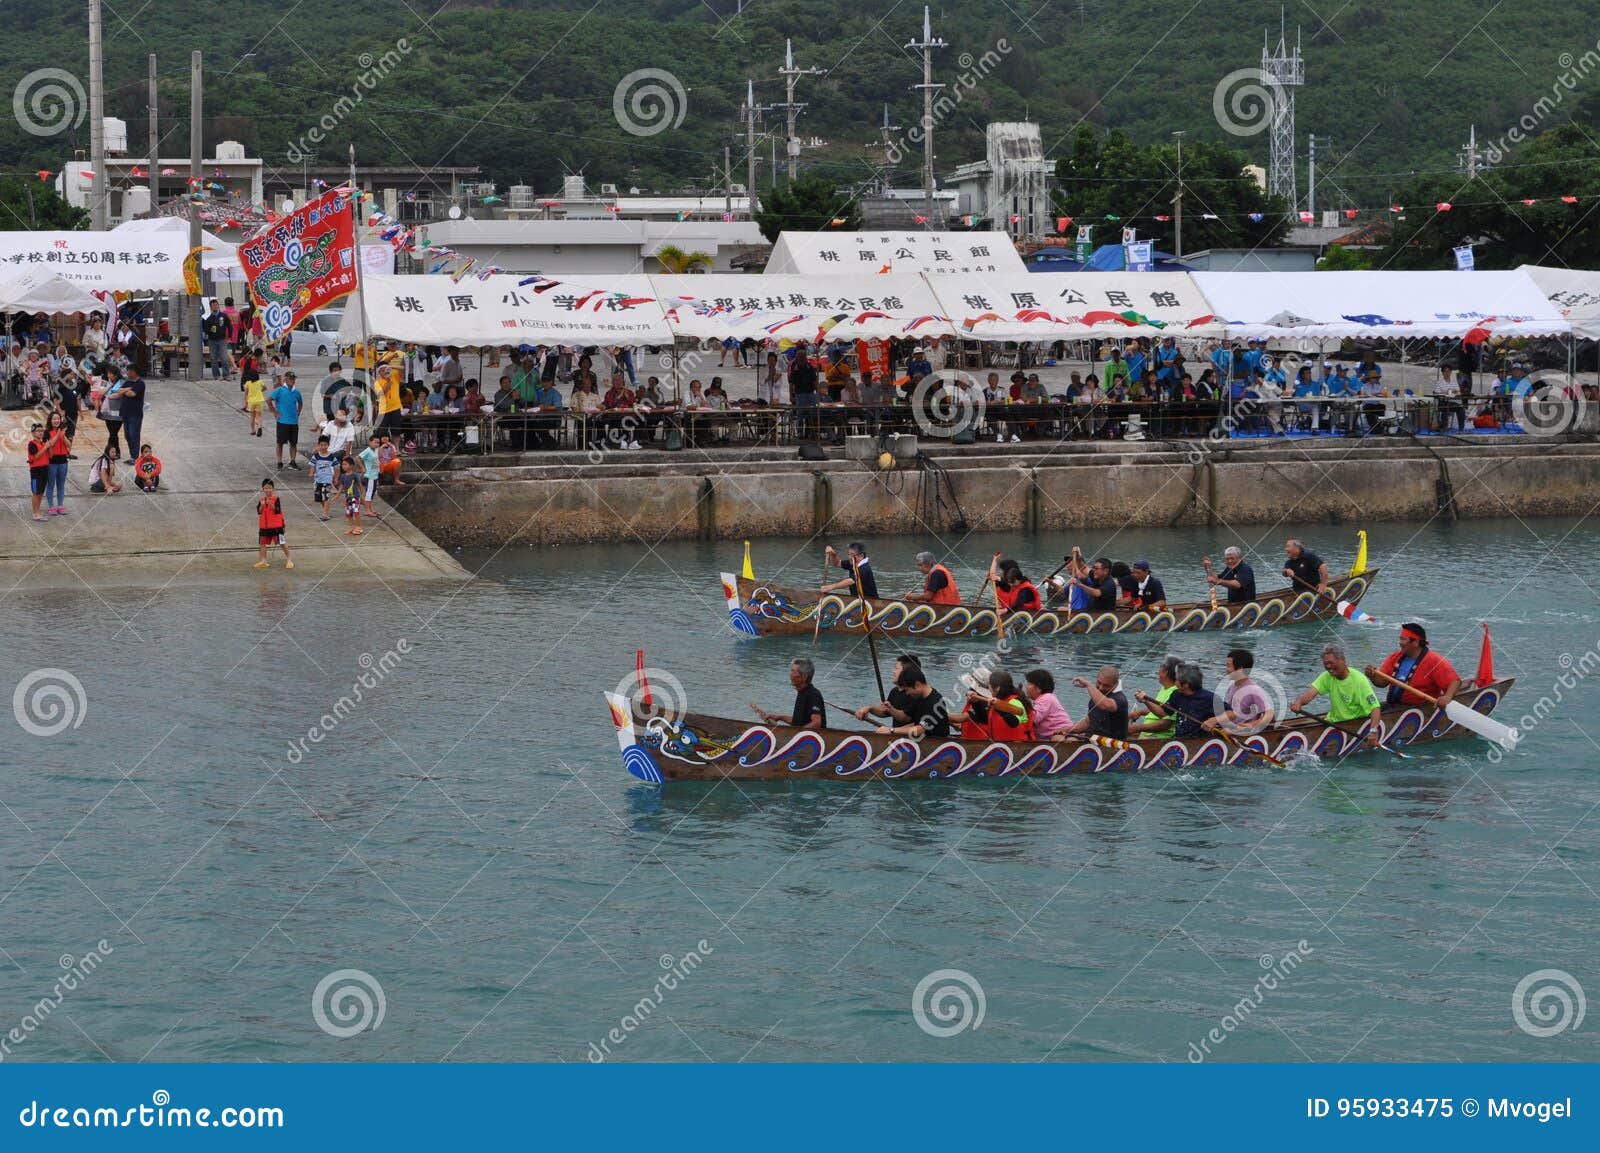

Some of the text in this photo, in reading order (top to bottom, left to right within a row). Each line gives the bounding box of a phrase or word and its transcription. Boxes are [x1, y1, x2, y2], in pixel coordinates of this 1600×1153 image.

[818, 245, 990, 262] 桃原公民館
[963, 288, 1181, 310] 桃原公民館
